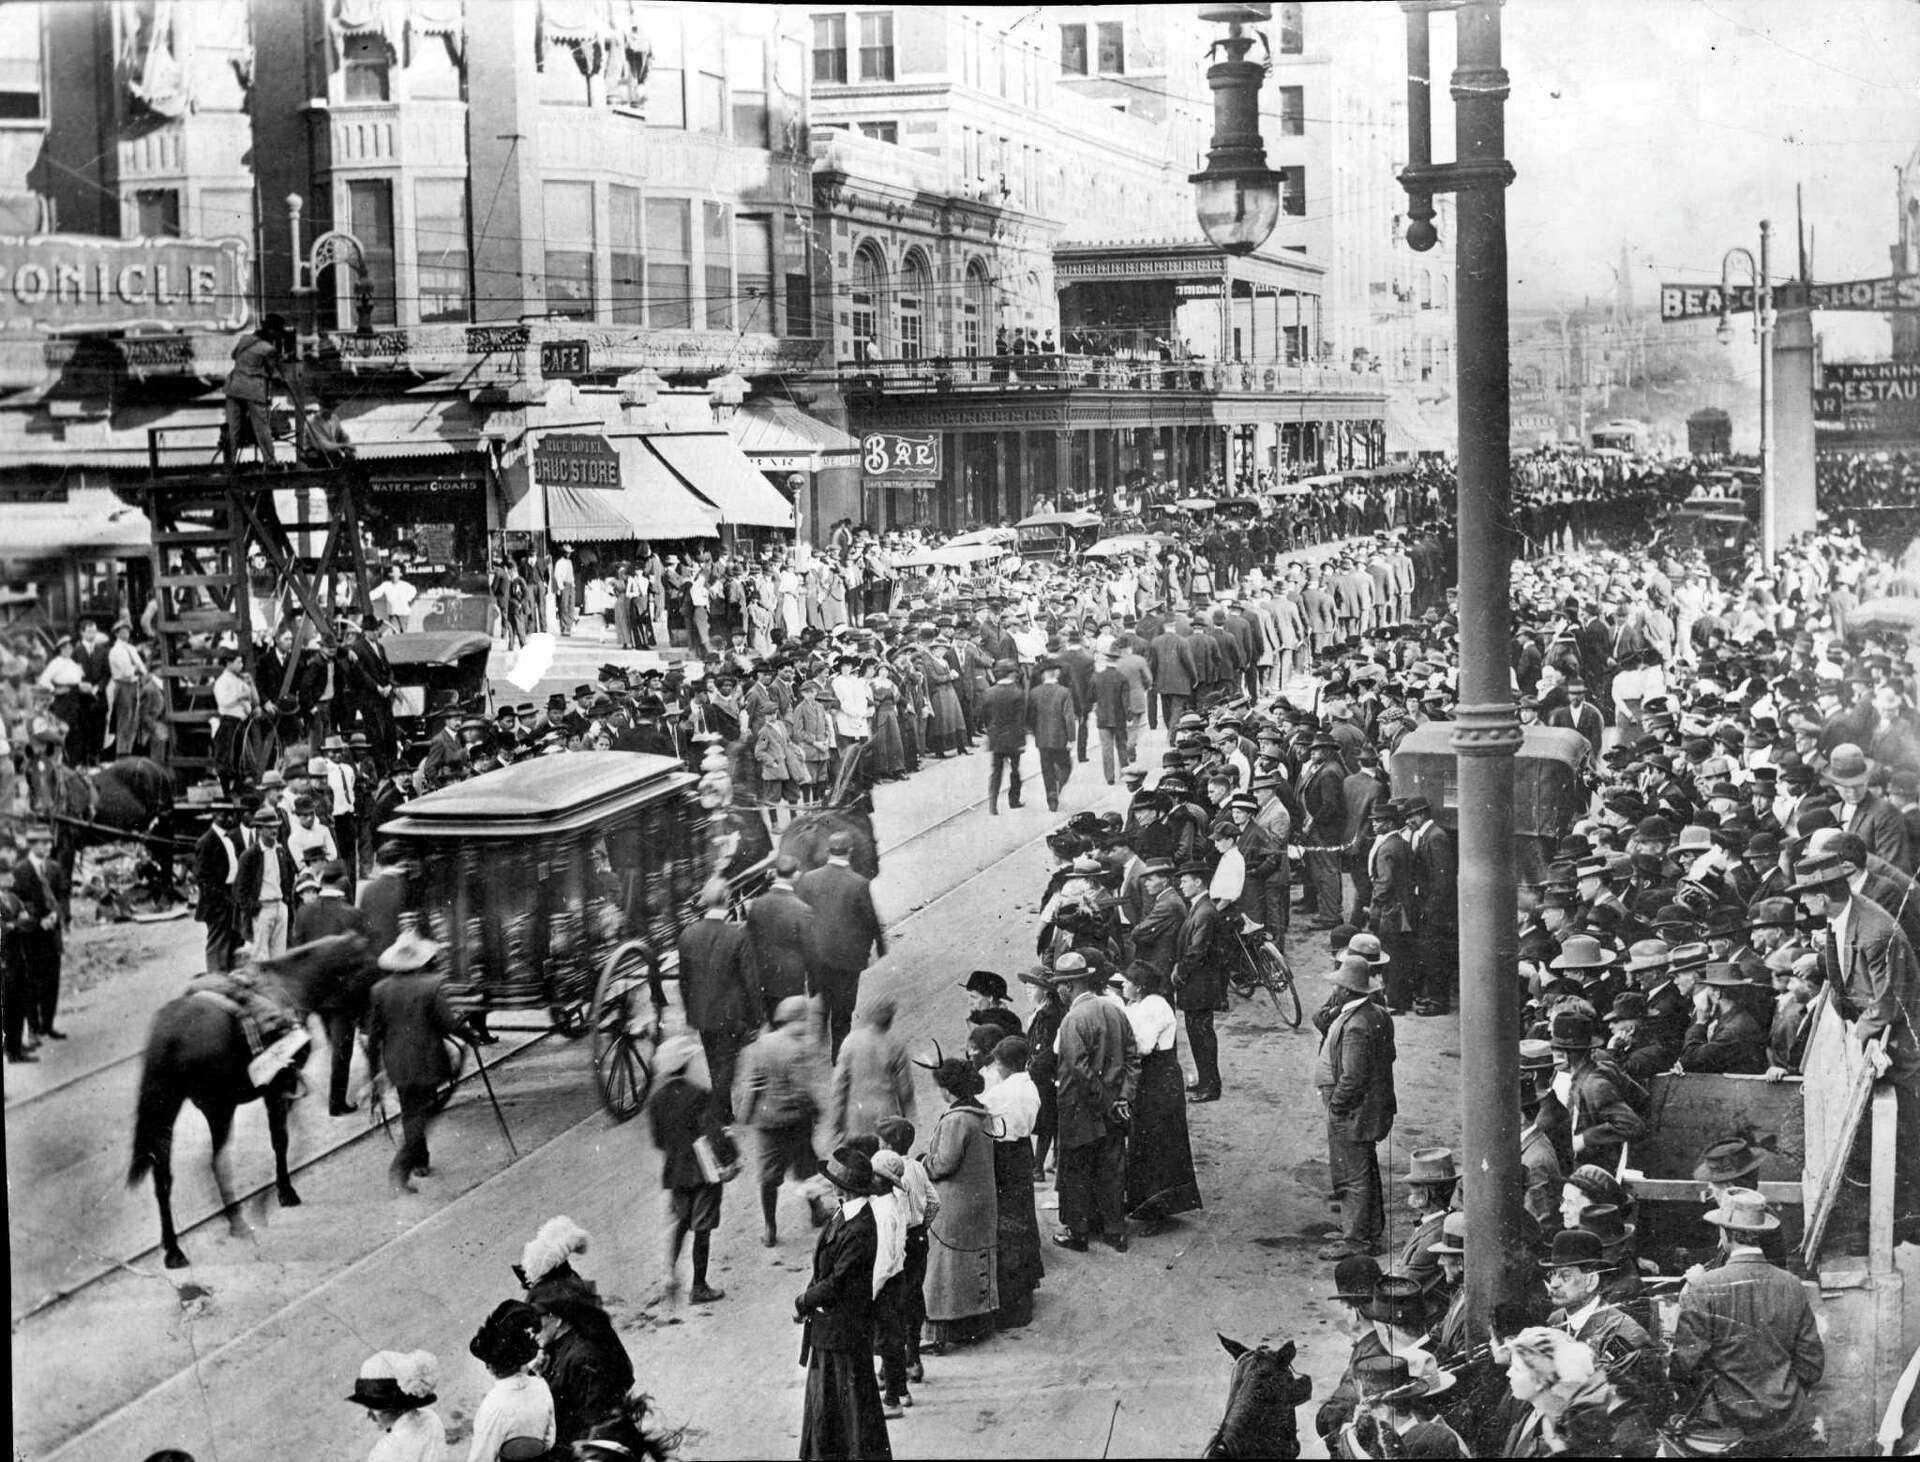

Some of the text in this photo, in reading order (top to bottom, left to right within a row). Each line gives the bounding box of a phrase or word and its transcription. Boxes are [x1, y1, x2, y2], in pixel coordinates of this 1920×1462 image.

[0, 263, 216, 304] ONICLE
[1810, 277, 1920, 309] SHOES
[542, 347, 580, 372] CAFE
[864, 432, 935, 475] BAR
[535, 457, 617, 484] DRUG STORE
[372, 483, 411, 492] WATER
[430, 481, 477, 492] CIGARS
